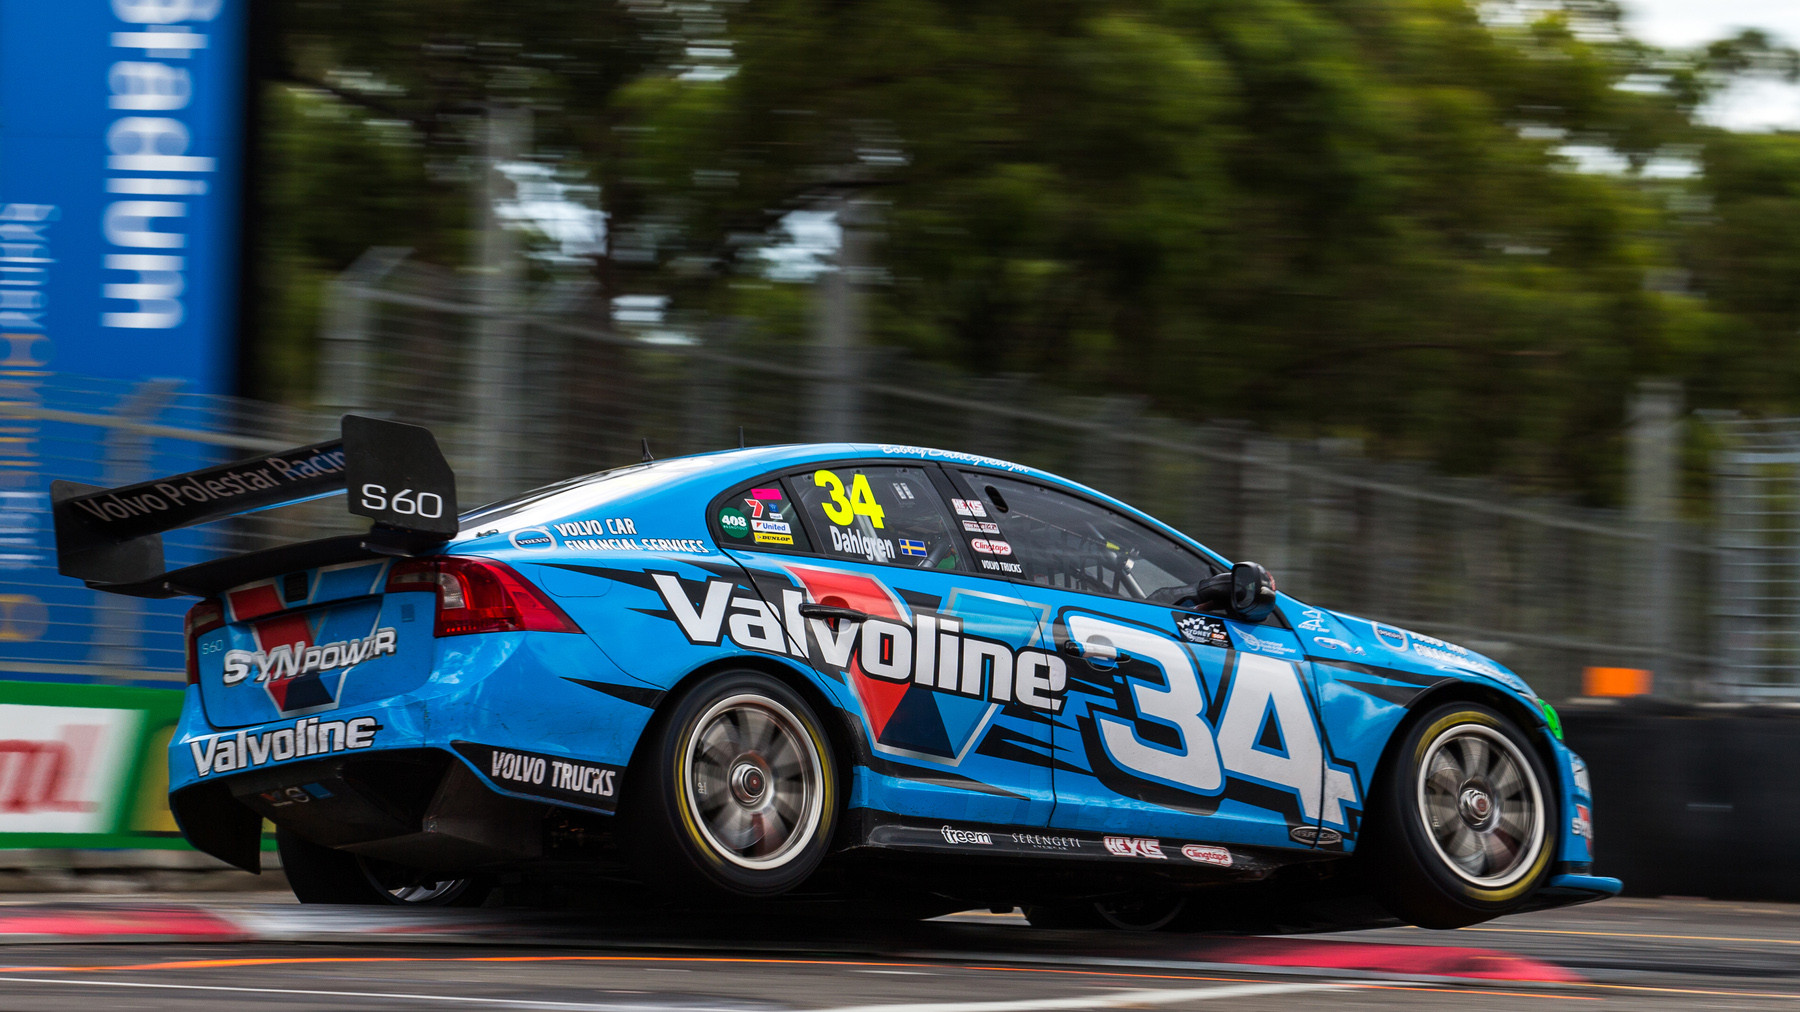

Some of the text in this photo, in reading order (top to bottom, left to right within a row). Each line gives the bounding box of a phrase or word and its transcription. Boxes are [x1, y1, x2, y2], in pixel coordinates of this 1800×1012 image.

[74, 448, 345, 522] Volvo Polestar Racin
[361, 482, 443, 520] S60
[814, 469, 885, 529] 34
[553, 517, 638, 538] VOLVO CAR
[721, 515, 747, 527] 408
[762, 522, 786, 531] United
[517, 537, 550, 545] VOLVO
[564, 538, 710, 553] FINANCIAL SERVICES
[829, 525, 896, 562] Dahlgren
[974, 541, 1009, 554] Clingtape
[981, 560, 1022, 573] VOLVO TRUCKS
[202, 639, 224, 655] S60
[651, 572, 1069, 711] Valvoline
[1068, 615, 1358, 825] 34
[190, 716, 378, 777] Valvoline
[491, 750, 616, 797] VOLVO TRUCKS
[941, 825, 993, 844] freem
[1011, 832, 1081, 847] SERENGETI
[1104, 836, 1167, 859] HEXIS
[1186, 848, 1229, 862] Clingtape
